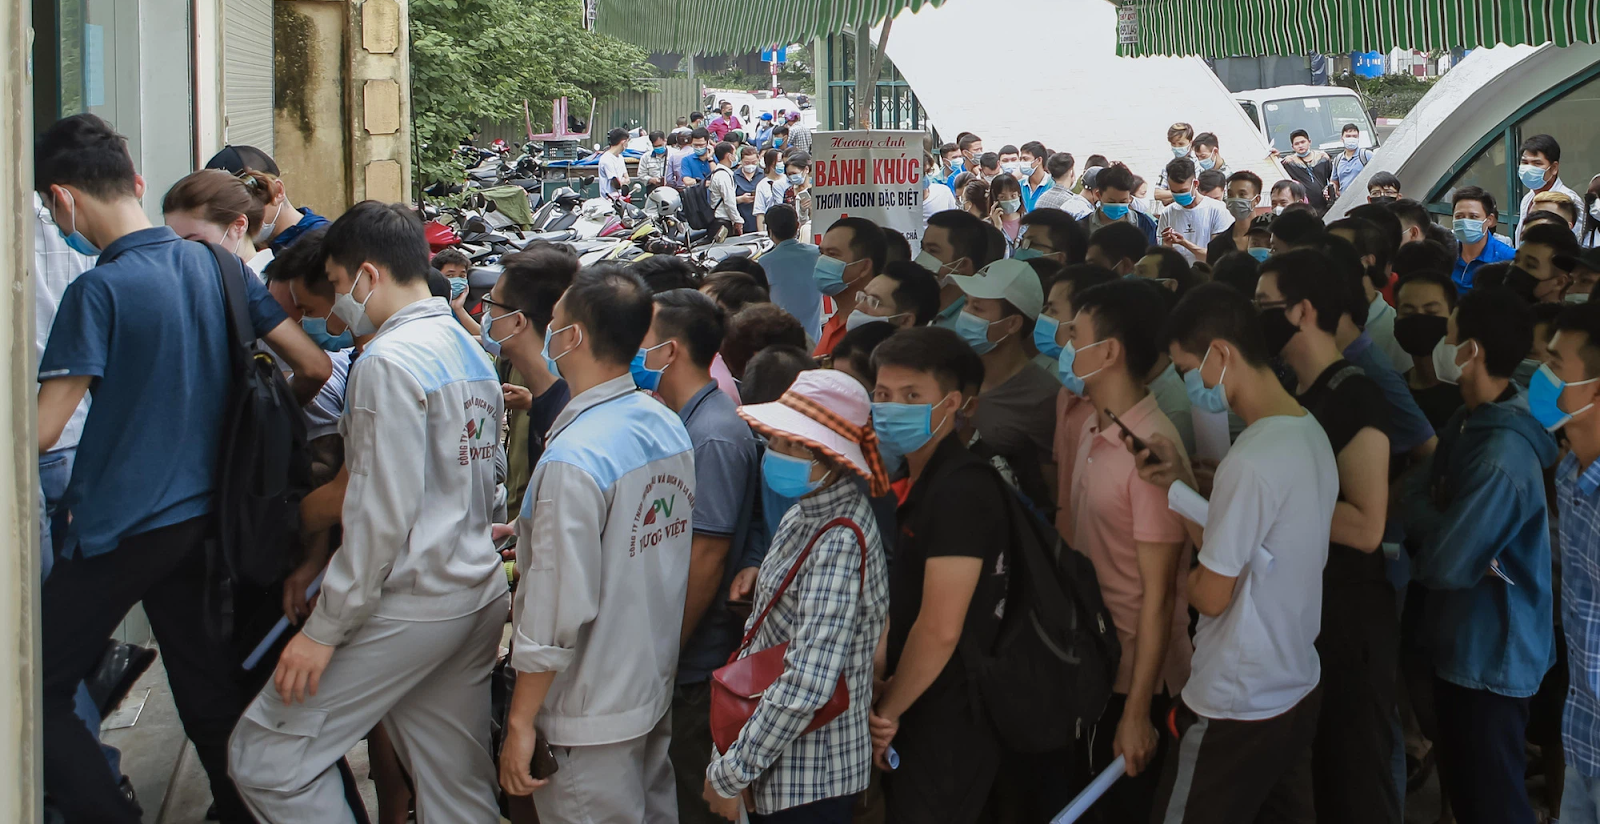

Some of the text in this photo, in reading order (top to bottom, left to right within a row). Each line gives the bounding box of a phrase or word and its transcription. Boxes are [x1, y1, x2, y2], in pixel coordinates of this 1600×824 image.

[831, 137, 873, 149] Hương
[815, 153, 920, 187] BÁNH KHÚC
[815, 188, 919, 210] THƠM NGON ĐẶC BIỆT
[458, 446, 469, 466] CÔNG
[631, 523, 638, 533] TY
[664, 517, 688, 539] VIỆT
[629, 535, 637, 558] CÔNG
